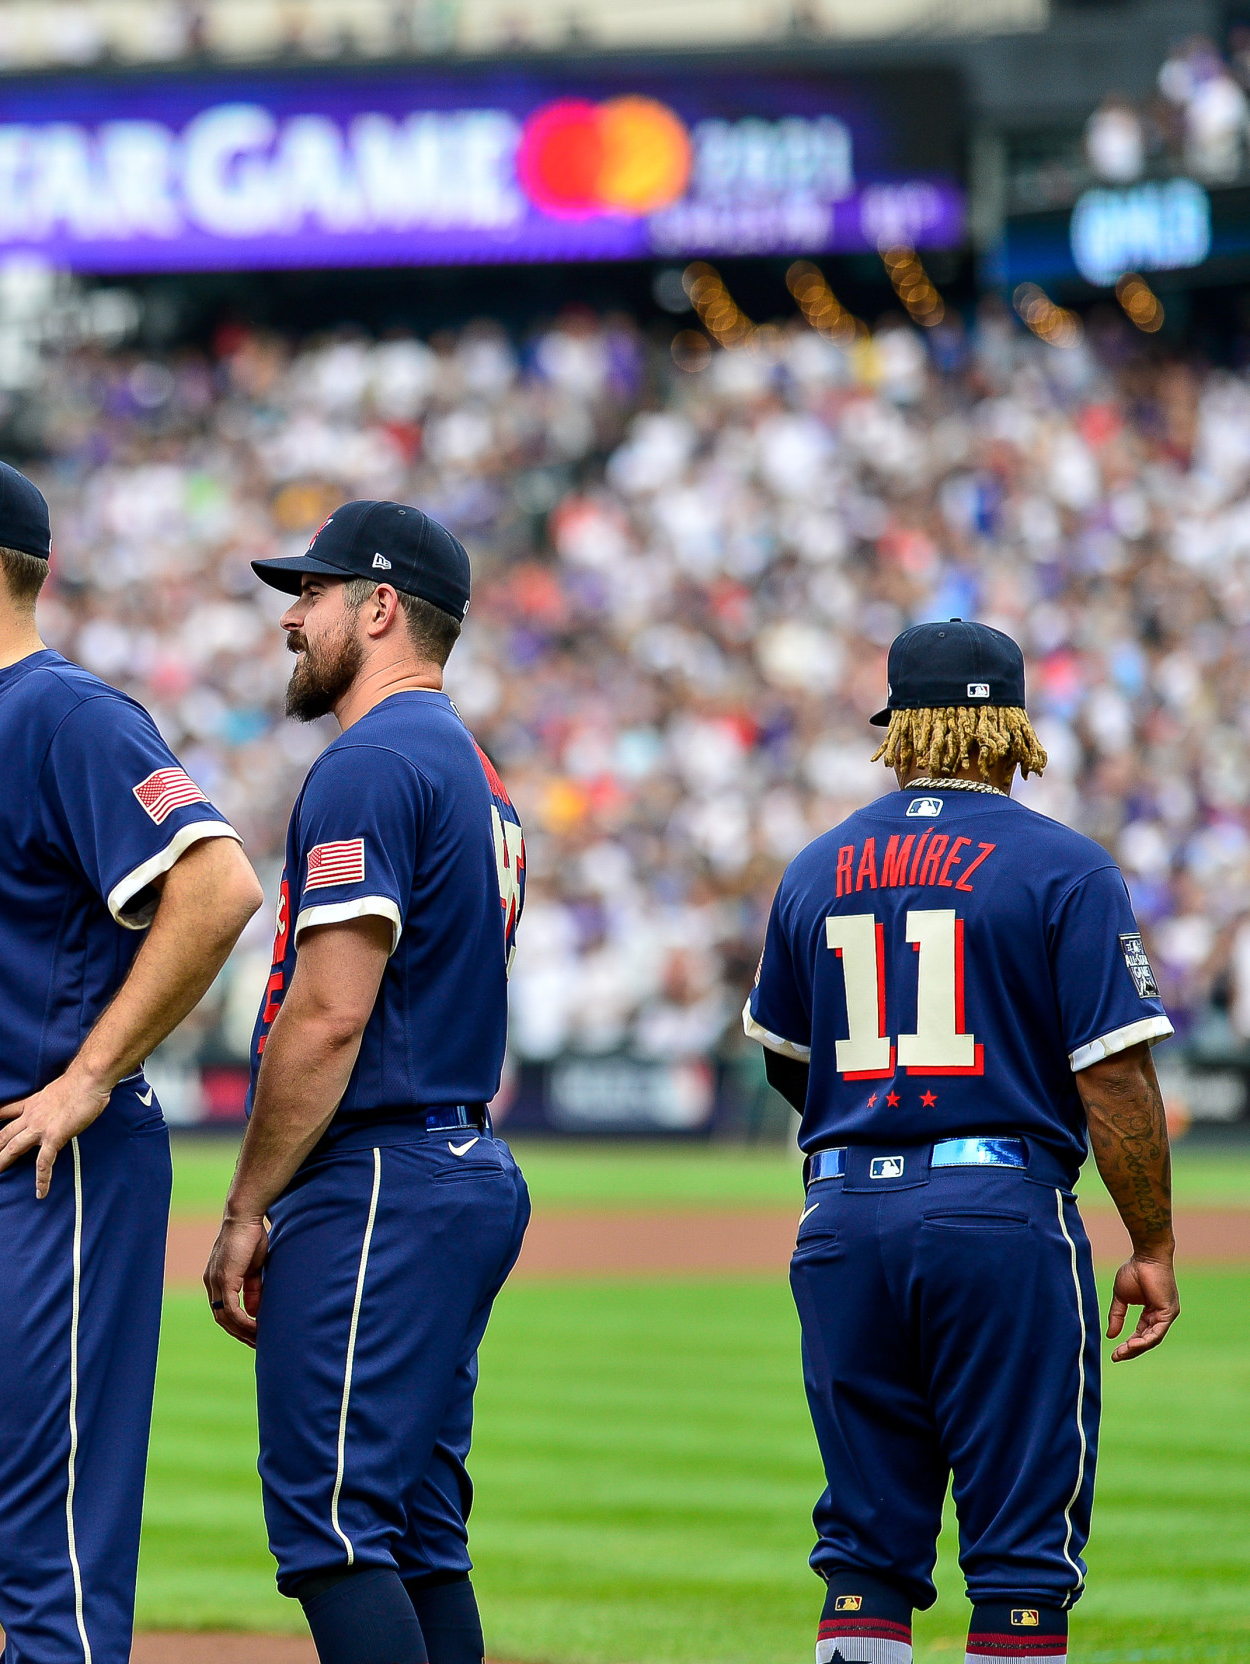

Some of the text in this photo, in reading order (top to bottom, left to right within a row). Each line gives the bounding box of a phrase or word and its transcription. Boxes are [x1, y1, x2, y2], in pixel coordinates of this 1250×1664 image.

[180, 102, 523, 240] GAME
[835, 827, 996, 898] RAMÍREZ
[825, 909, 984, 1081] 11
